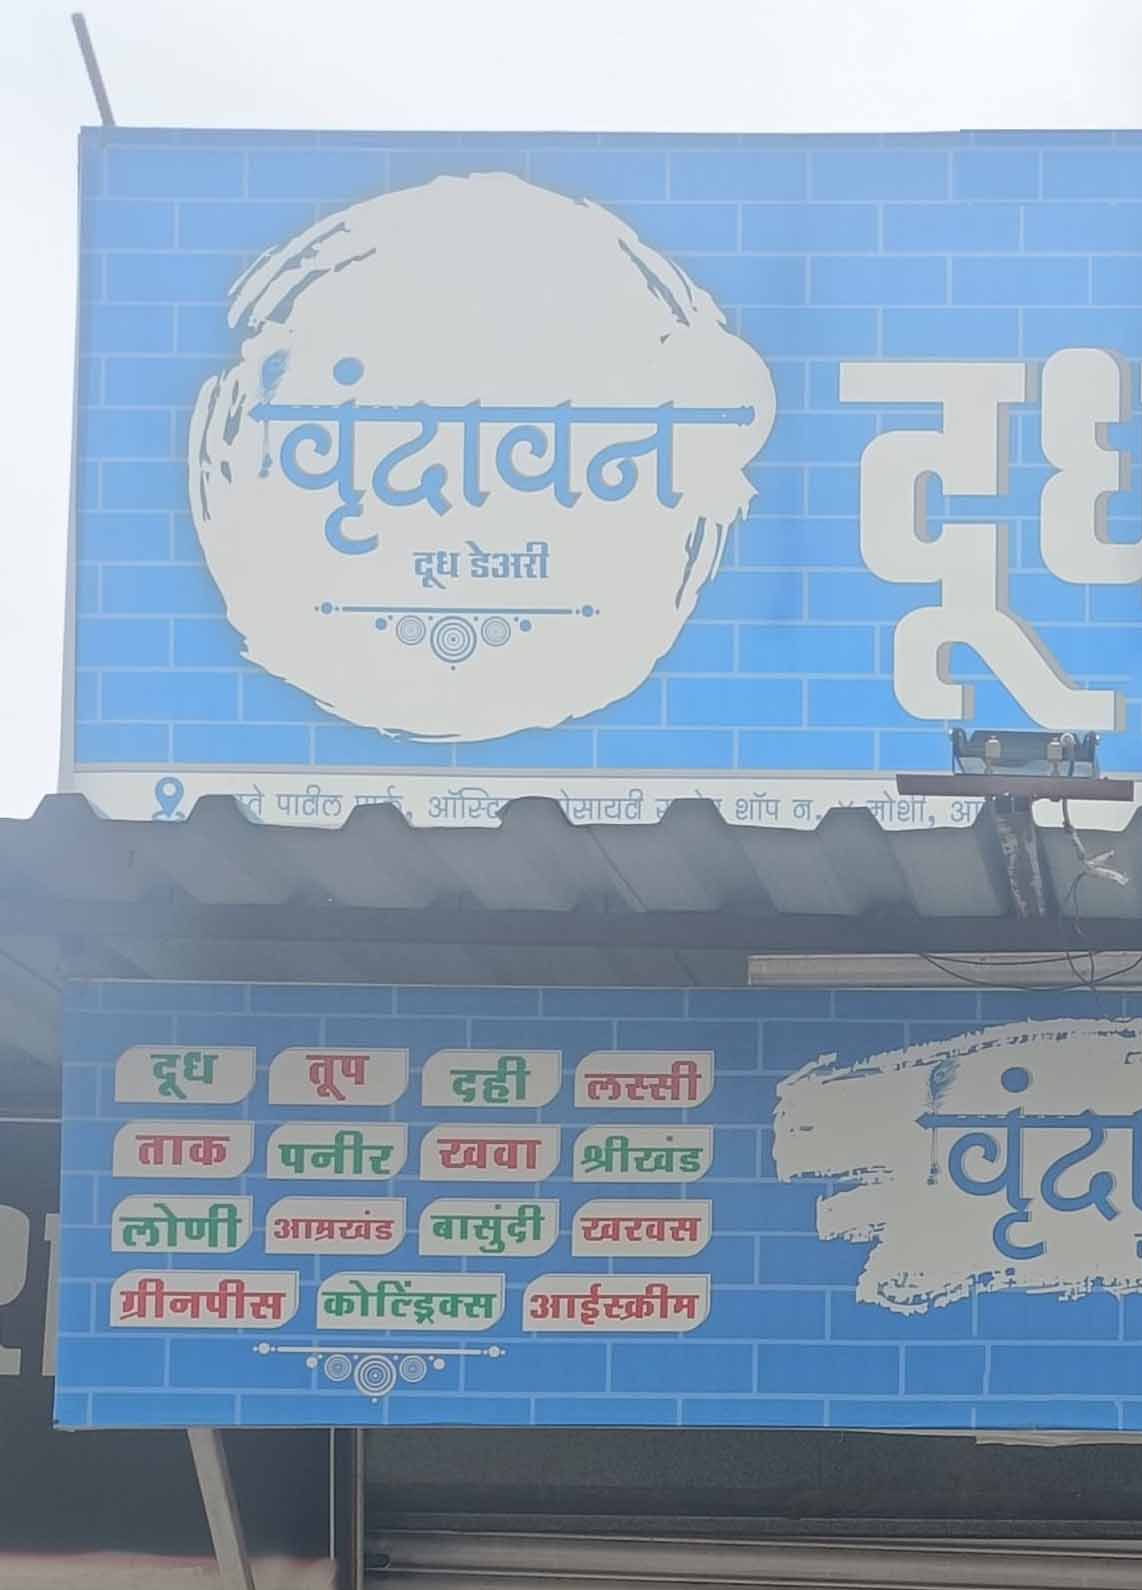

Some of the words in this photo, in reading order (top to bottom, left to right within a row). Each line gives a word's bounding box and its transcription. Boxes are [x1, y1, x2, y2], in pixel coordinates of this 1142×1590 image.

[252, 358, 756, 554] वृंदावन
[414, 549, 461, 591] दूध
[471, 539, 550, 580] डेअरी
[275, 785, 344, 817] पाटील
[735, 792, 782, 821] शॉप
[150, 1051, 219, 1100] दूध
[306, 1054, 370, 1101] तूप
[449, 1055, 531, 1104] दही
[584, 1060, 703, 1102] लस्सी
[136, 1134, 230, 1166] ताक
[278, 1130, 394, 1175] पनीर
[437, 1138, 542, 1171] खवा
[581, 1135, 704, 1174] श्रीखंड
[119, 1202, 242, 1249] लोणी
[273, 1210, 395, 1242] आम्रखंड
[430, 1204, 545, 1254] बासुंदी
[580, 1217, 701, 1243] खरवस
[119, 1277, 287, 1321] ग्रीनपीस
[529, 1282, 700, 1326] आईस्क्रीम
